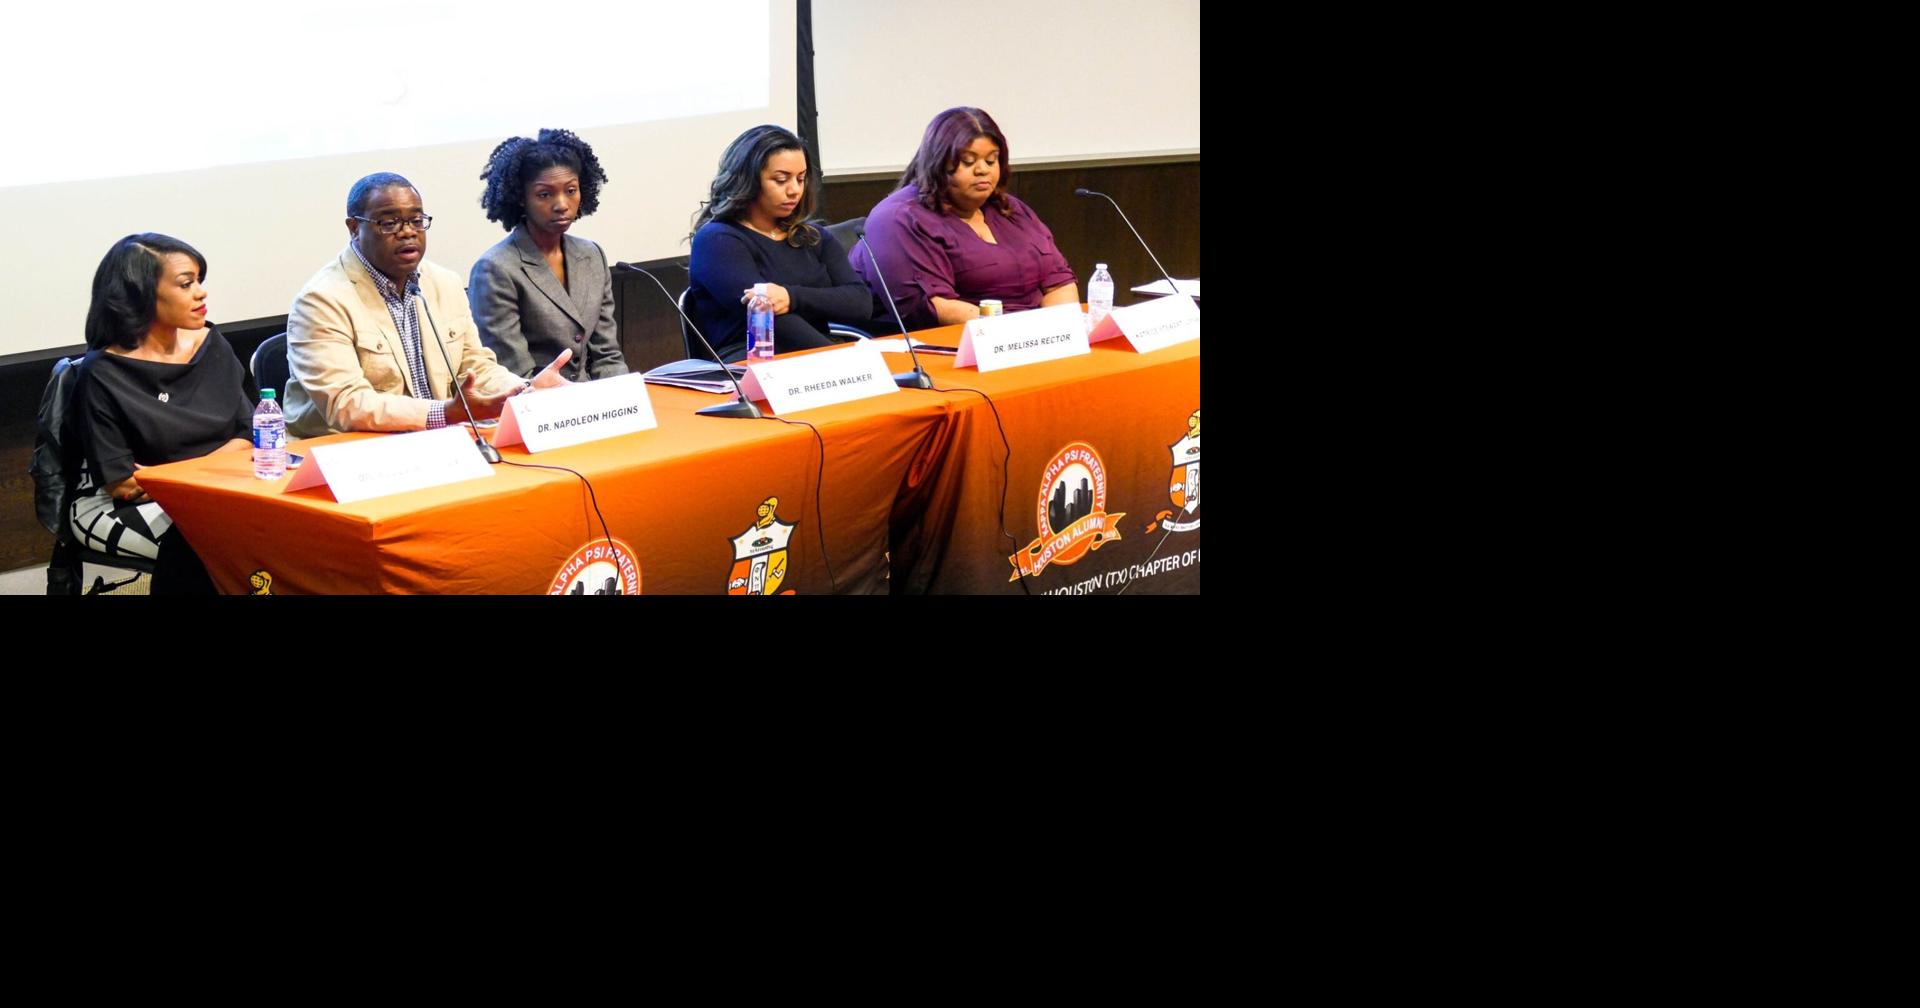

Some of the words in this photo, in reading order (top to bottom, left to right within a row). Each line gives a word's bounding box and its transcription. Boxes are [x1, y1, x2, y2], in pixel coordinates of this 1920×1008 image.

[994, 345, 1006, 354] DR.
[1007, 339, 1039, 351] MELISSA
[1040, 333, 1071, 345] RECTOR
[788, 387, 803, 396] DR.
[804, 380, 838, 393] RHEEDA
[839, 373, 873, 386] WALKER
[537, 423, 552, 433] DR.
[553, 412, 600, 430] NAPOLEON
[601, 405, 639, 420] HIGGINS
[1042, 459, 1065, 497] ALPHA
[1064, 450, 1079, 464] PSI
[1079, 450, 1105, 509] FRATERNITY
[1034, 531, 1071, 574] HOUSTON
[1072, 517, 1104, 540] ALUMNI
[551, 557, 585, 595] ALPHA
[585, 546, 605, 562] PSI
[605, 547, 638, 595] FRATERNI
[1105, 567, 1128, 589] (TX)
[1129, 555, 1180, 579] CHAPTER
[1181, 550, 1197, 567] OF
